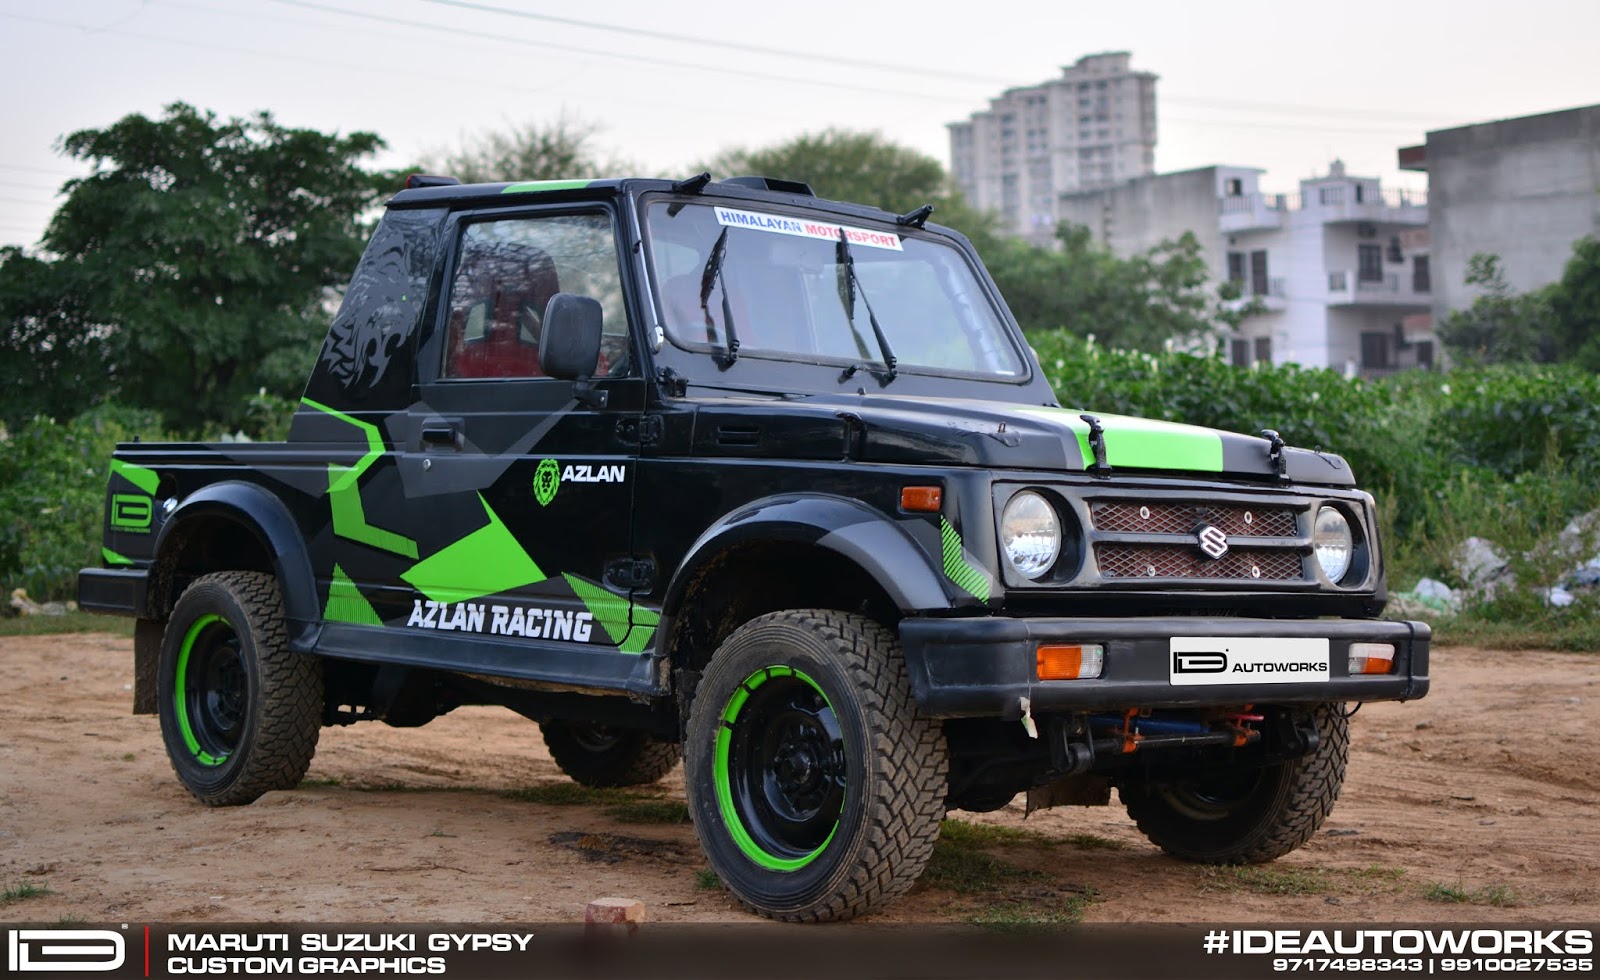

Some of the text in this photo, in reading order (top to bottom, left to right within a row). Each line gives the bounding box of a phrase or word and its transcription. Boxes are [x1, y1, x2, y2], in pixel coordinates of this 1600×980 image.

[720, 211, 802, 233] HIMALAYAN
[561, 465, 626, 482] AZLAN
[407, 600, 593, 642] AZLAN RACING
[1232, 662, 1328, 673] AUTOWORKS
